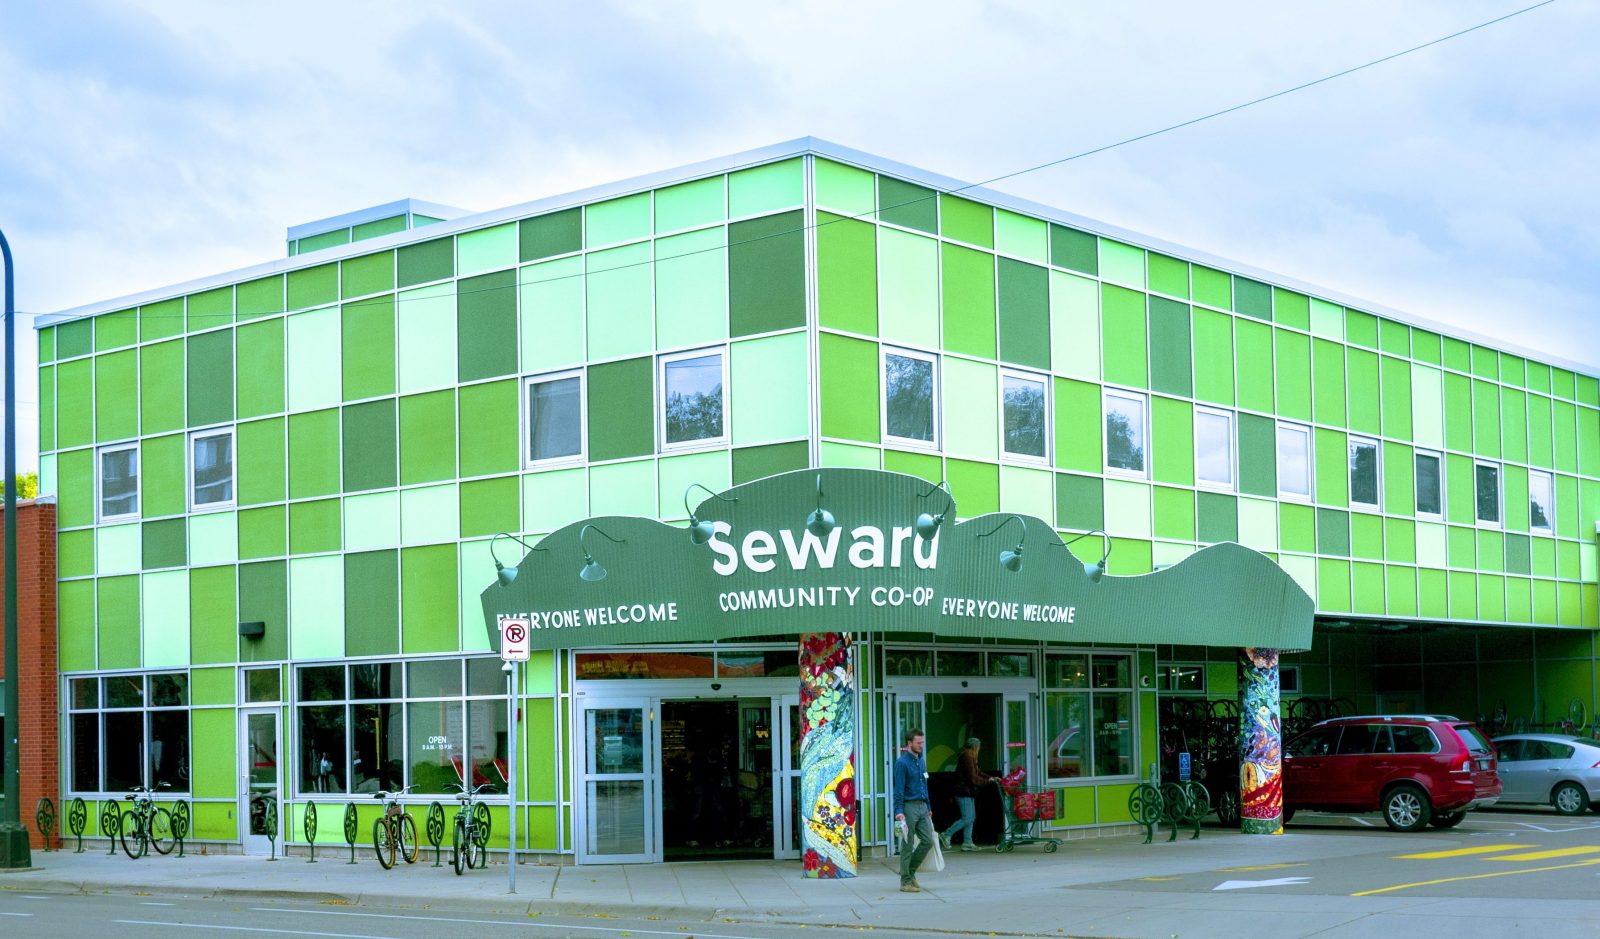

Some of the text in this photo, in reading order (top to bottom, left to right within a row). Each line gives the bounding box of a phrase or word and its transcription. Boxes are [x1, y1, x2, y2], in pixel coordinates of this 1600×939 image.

[708, 515, 940, 576] Seward
[719, 587, 933, 612] COMMUNITY CO-OP
[942, 598, 1075, 623] EVERYONE WELCOME
[584, 603, 678, 626] WELCOME
[428, 735, 446, 743] OPEN
